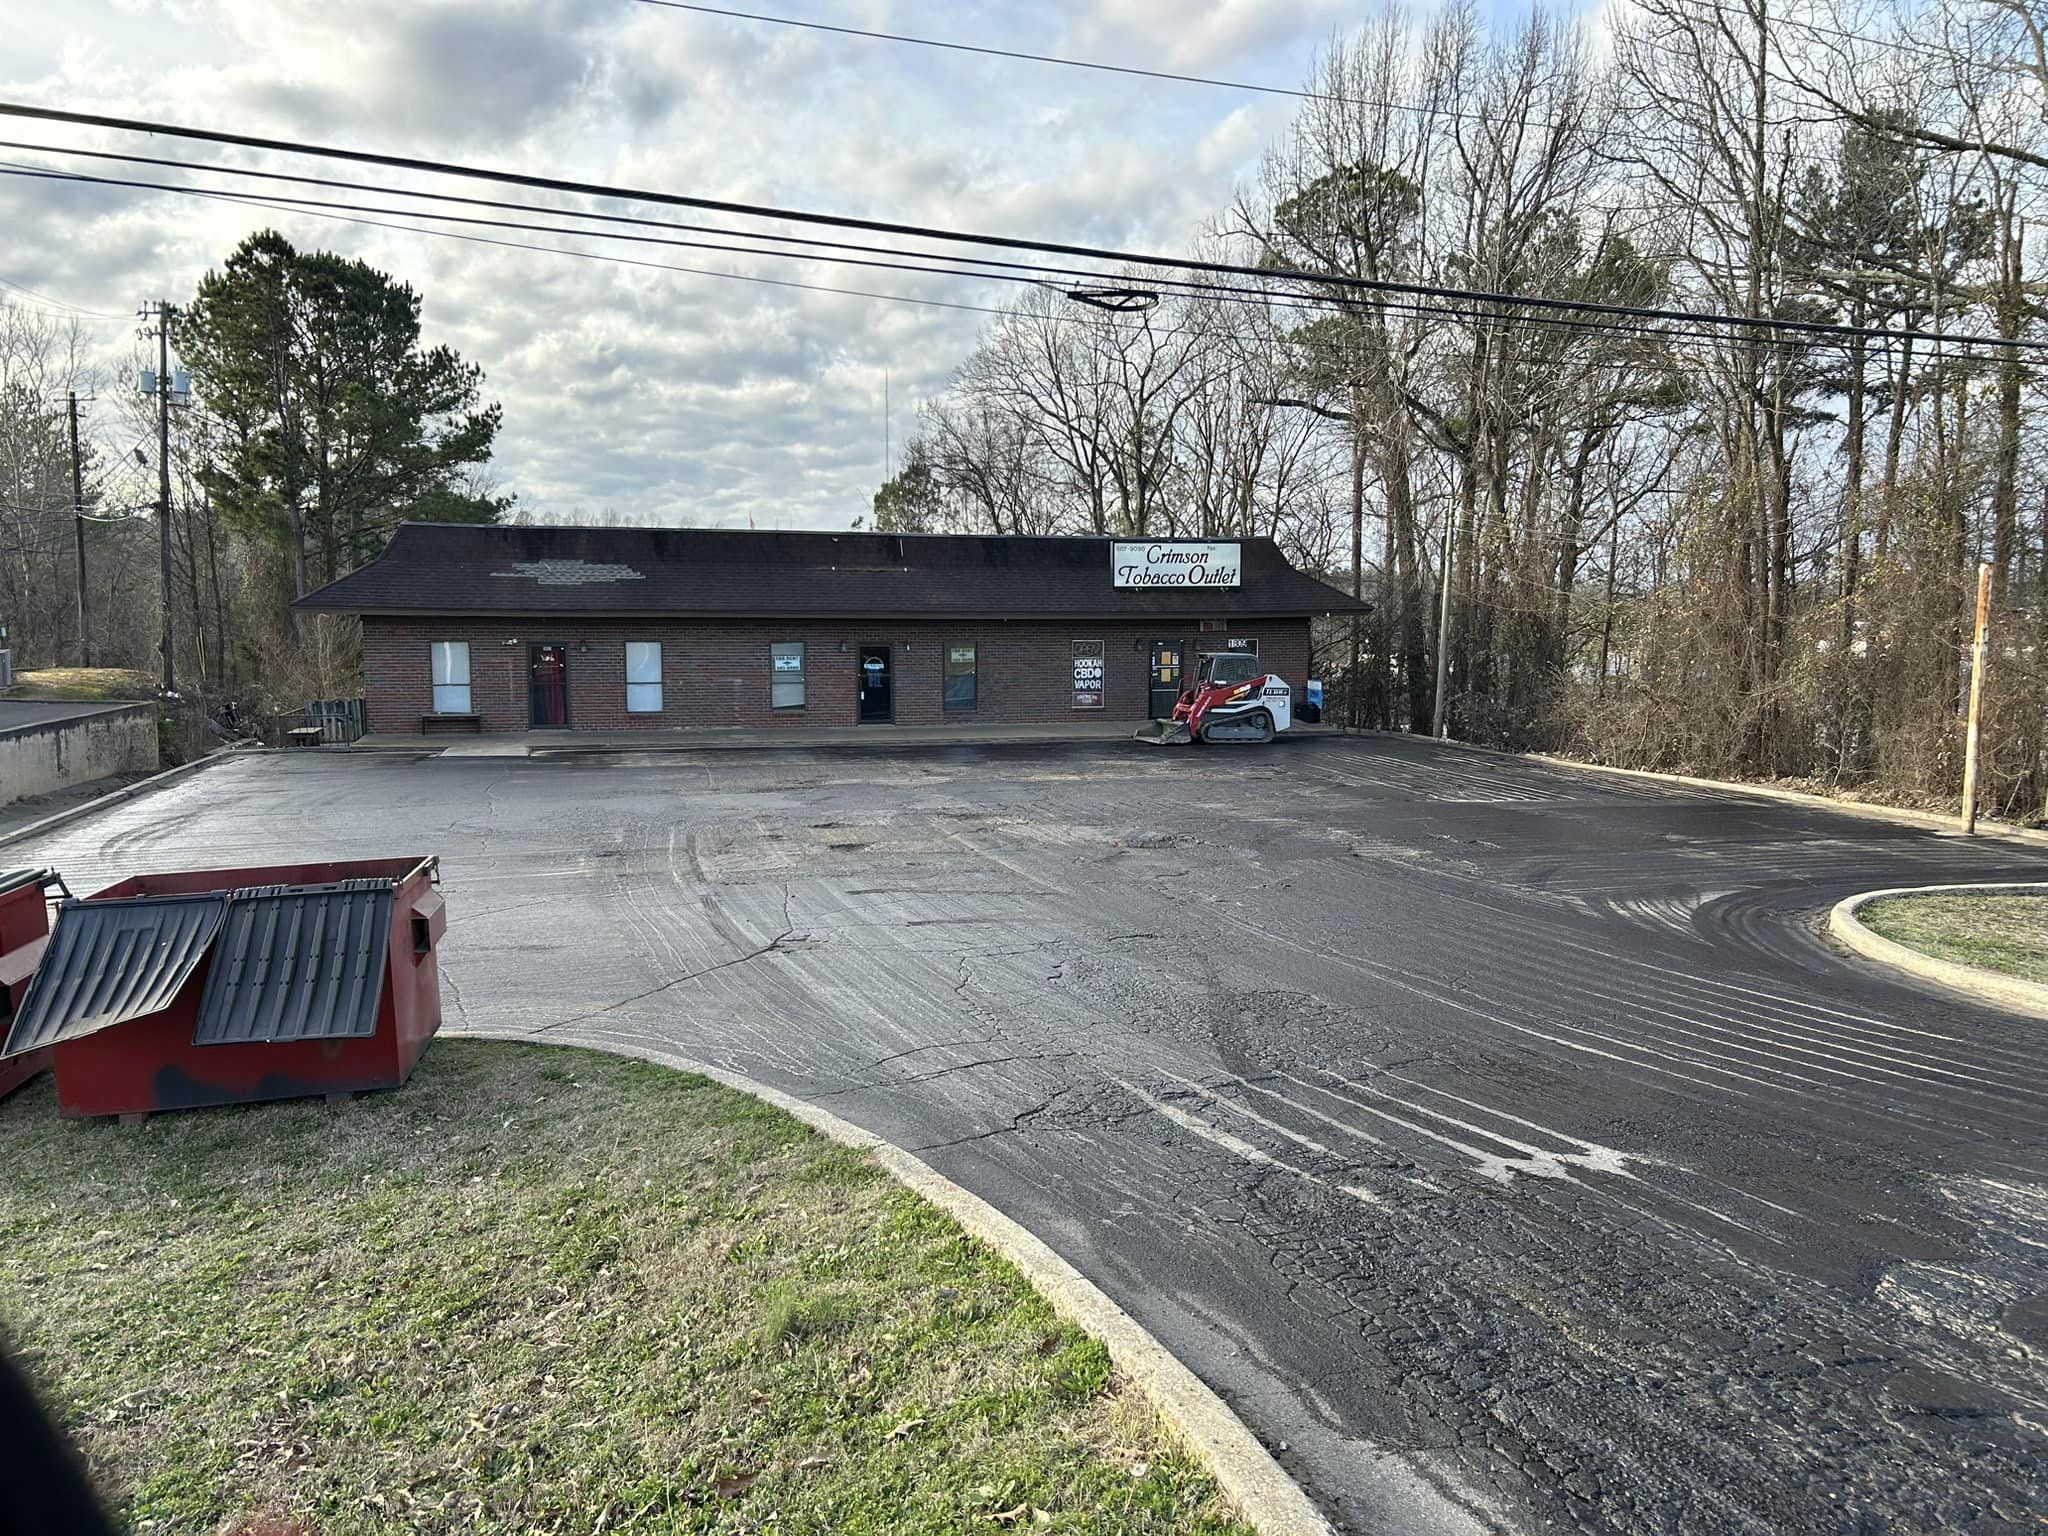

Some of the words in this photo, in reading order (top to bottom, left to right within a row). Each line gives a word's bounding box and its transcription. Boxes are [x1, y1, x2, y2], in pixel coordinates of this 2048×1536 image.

[1146, 544, 1209, 564] Crimson
[1118, 565, 1186, 584] Tobacco
[1188, 564, 1237, 584] Outlet
[1074, 659, 1103, 668] HOOKAH
[1074, 668, 1095, 679] CBD
[1074, 680, 1101, 689] VAPOR
